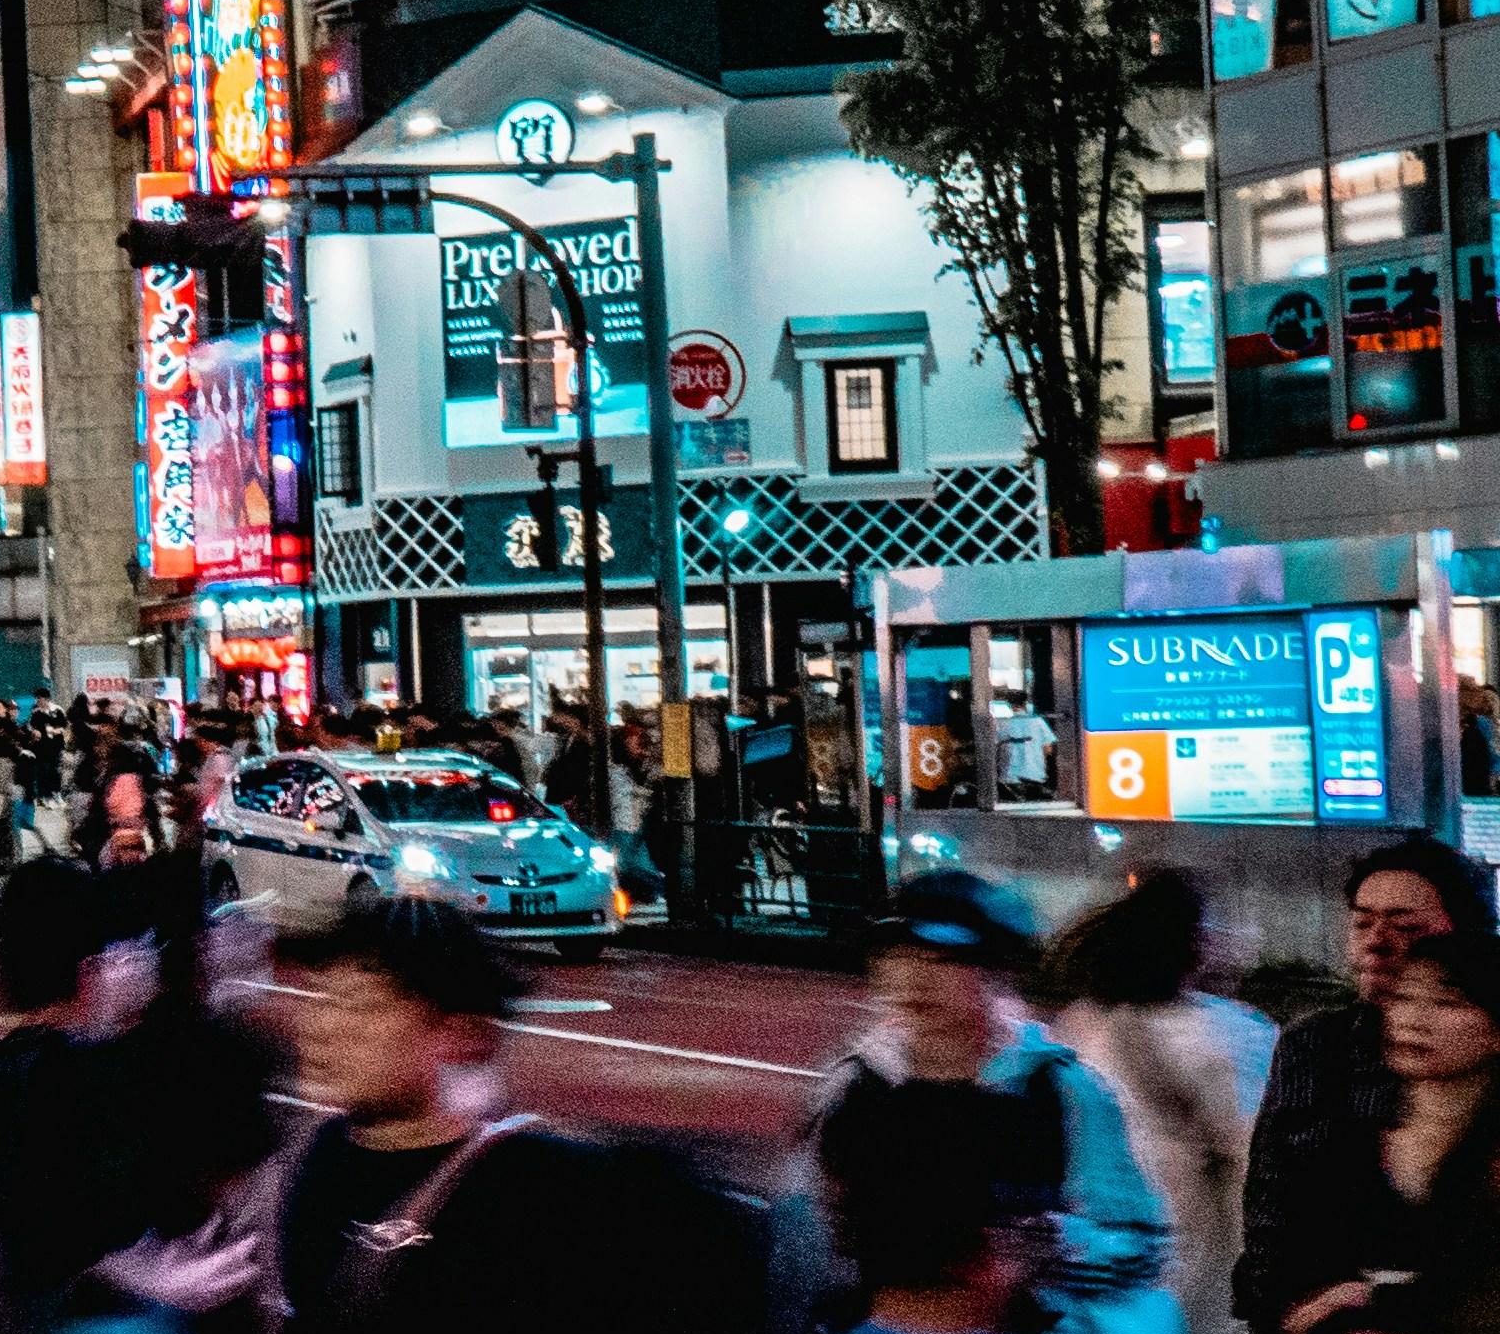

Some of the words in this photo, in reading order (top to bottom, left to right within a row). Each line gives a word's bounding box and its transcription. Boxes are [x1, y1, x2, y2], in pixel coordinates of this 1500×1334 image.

[1108, 631, 1306, 667] SUBNADE
[1321, 636, 1350, 705] P
[1108, 747, 1145, 799] 8
